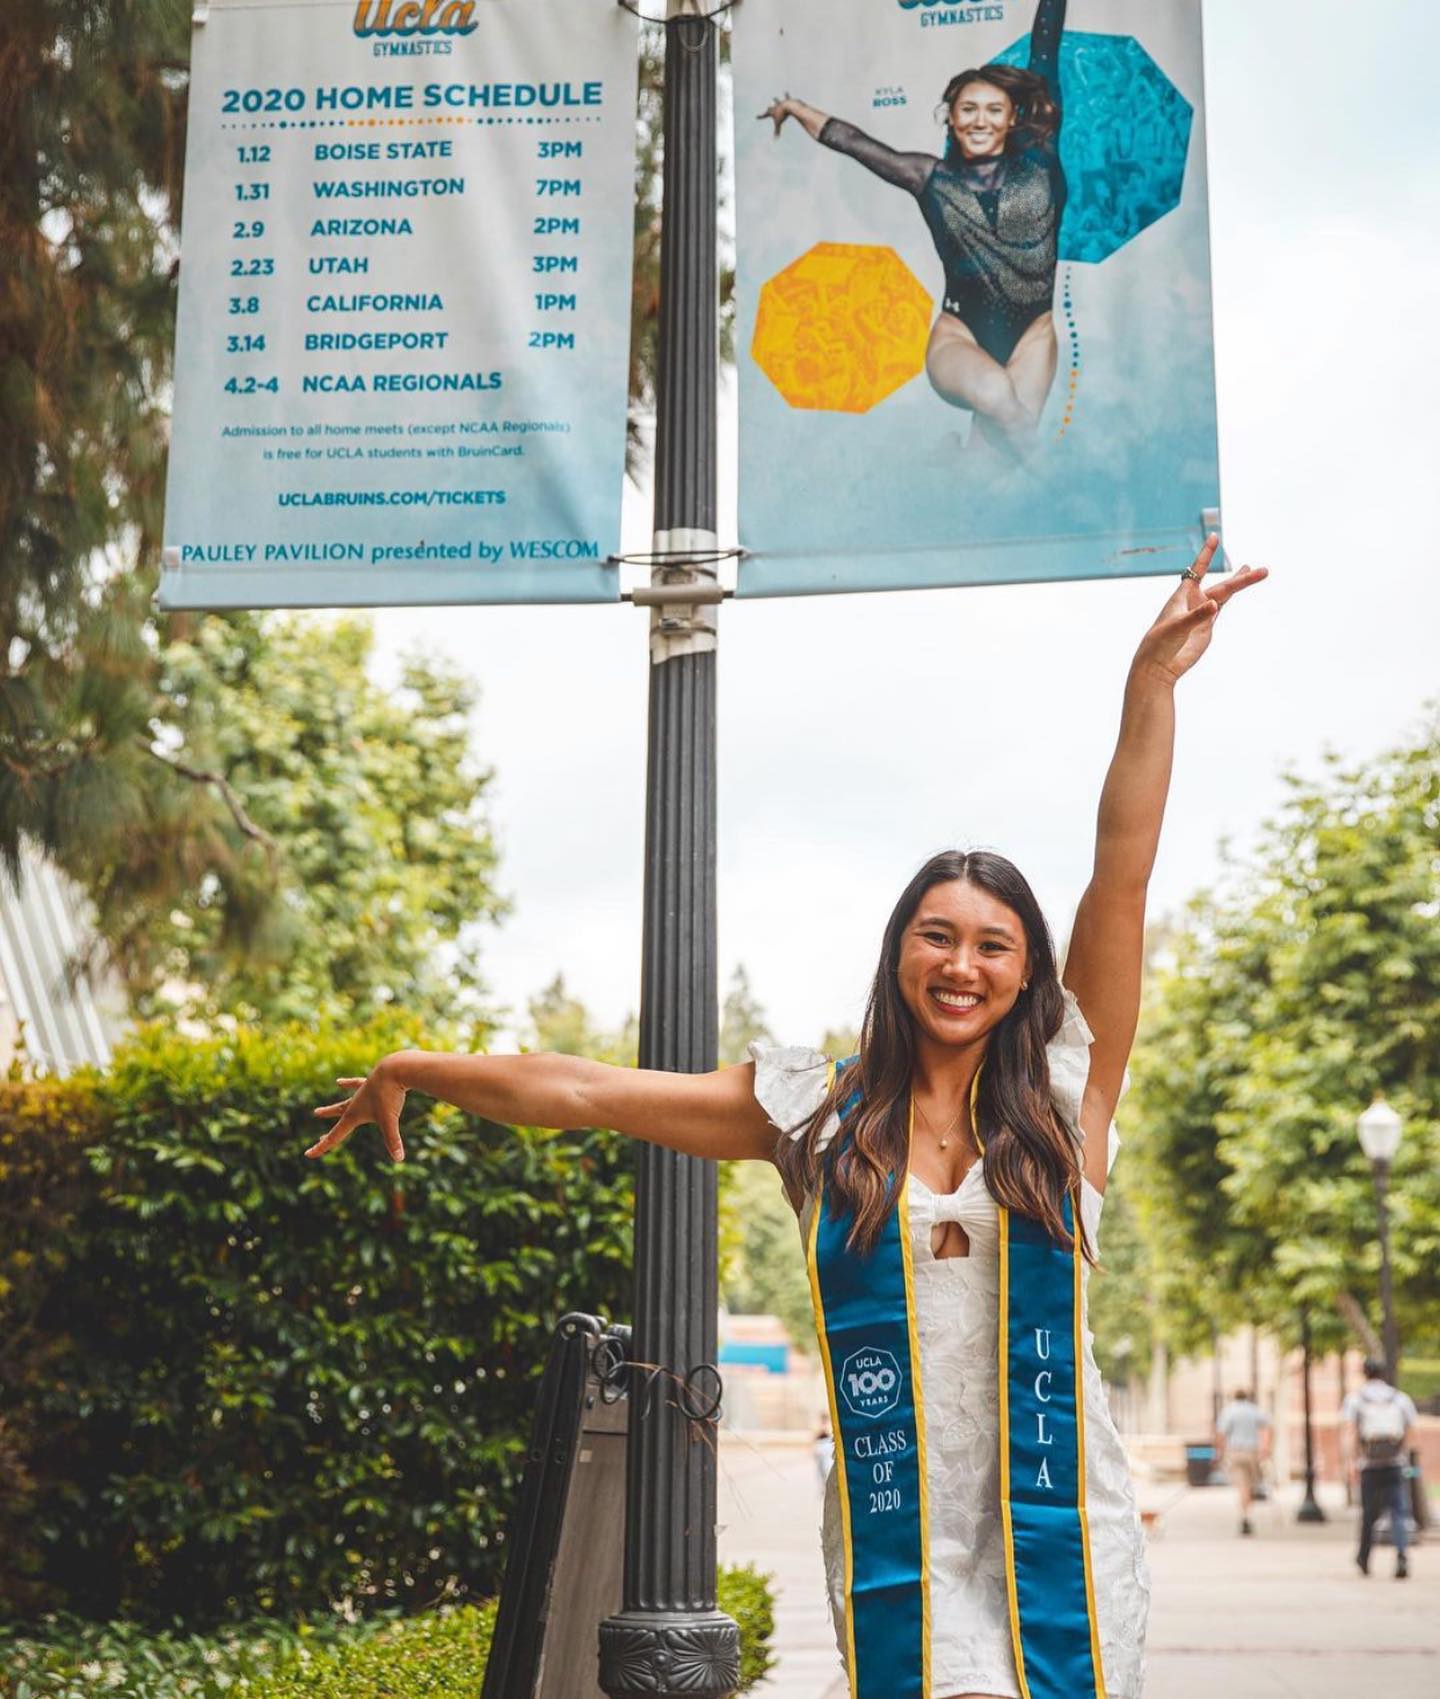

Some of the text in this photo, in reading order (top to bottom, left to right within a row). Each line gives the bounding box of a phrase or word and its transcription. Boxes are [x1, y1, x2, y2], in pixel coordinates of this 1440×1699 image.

[920, 6, 1003, 27] GYMNASTICS
[373, 40, 452, 57] GYMNASTICS
[222, 82, 603, 113] 2020 HOME SCHEDULE
[872, 96, 907, 107] ROSS
[237, 141, 582, 163] 1.12 BOISE STATE 3PM
[235, 178, 581, 200] 1.31 WASHINGTON 7PM
[233, 218, 580, 239] 2.9 ARIZONA 2PM
[230, 256, 578, 276] 2.23 UTAH 3PM
[228, 294, 576, 314] 3.8 CALIFORNIA 1PM
[226, 331, 575, 352] 3.14 BRIDGEPORT 2PM
[224, 372, 502, 394] 4.2-4 NCAA REGIONALS
[222, 421, 571, 438] Admission to all home meets (except NCAA Regionals)
[263, 445, 525, 460] is free for UCLA students with BruinCard.
[278, 490, 506, 507] UCLABRUINS.COM/TICKETS
[181, 540, 598, 564] PAULEY PAVILION presented by WESCOM
[856, 1356, 882, 1368] UCLA
[848, 1368, 896, 1398] 100
[860, 1396, 889, 1407] YEARS
[1034, 1328, 1053, 1489] UCLA
[854, 1430, 907, 1458] CLASS
[872, 1460, 894, 1484] OF
[869, 1489, 901, 1513] 2020
